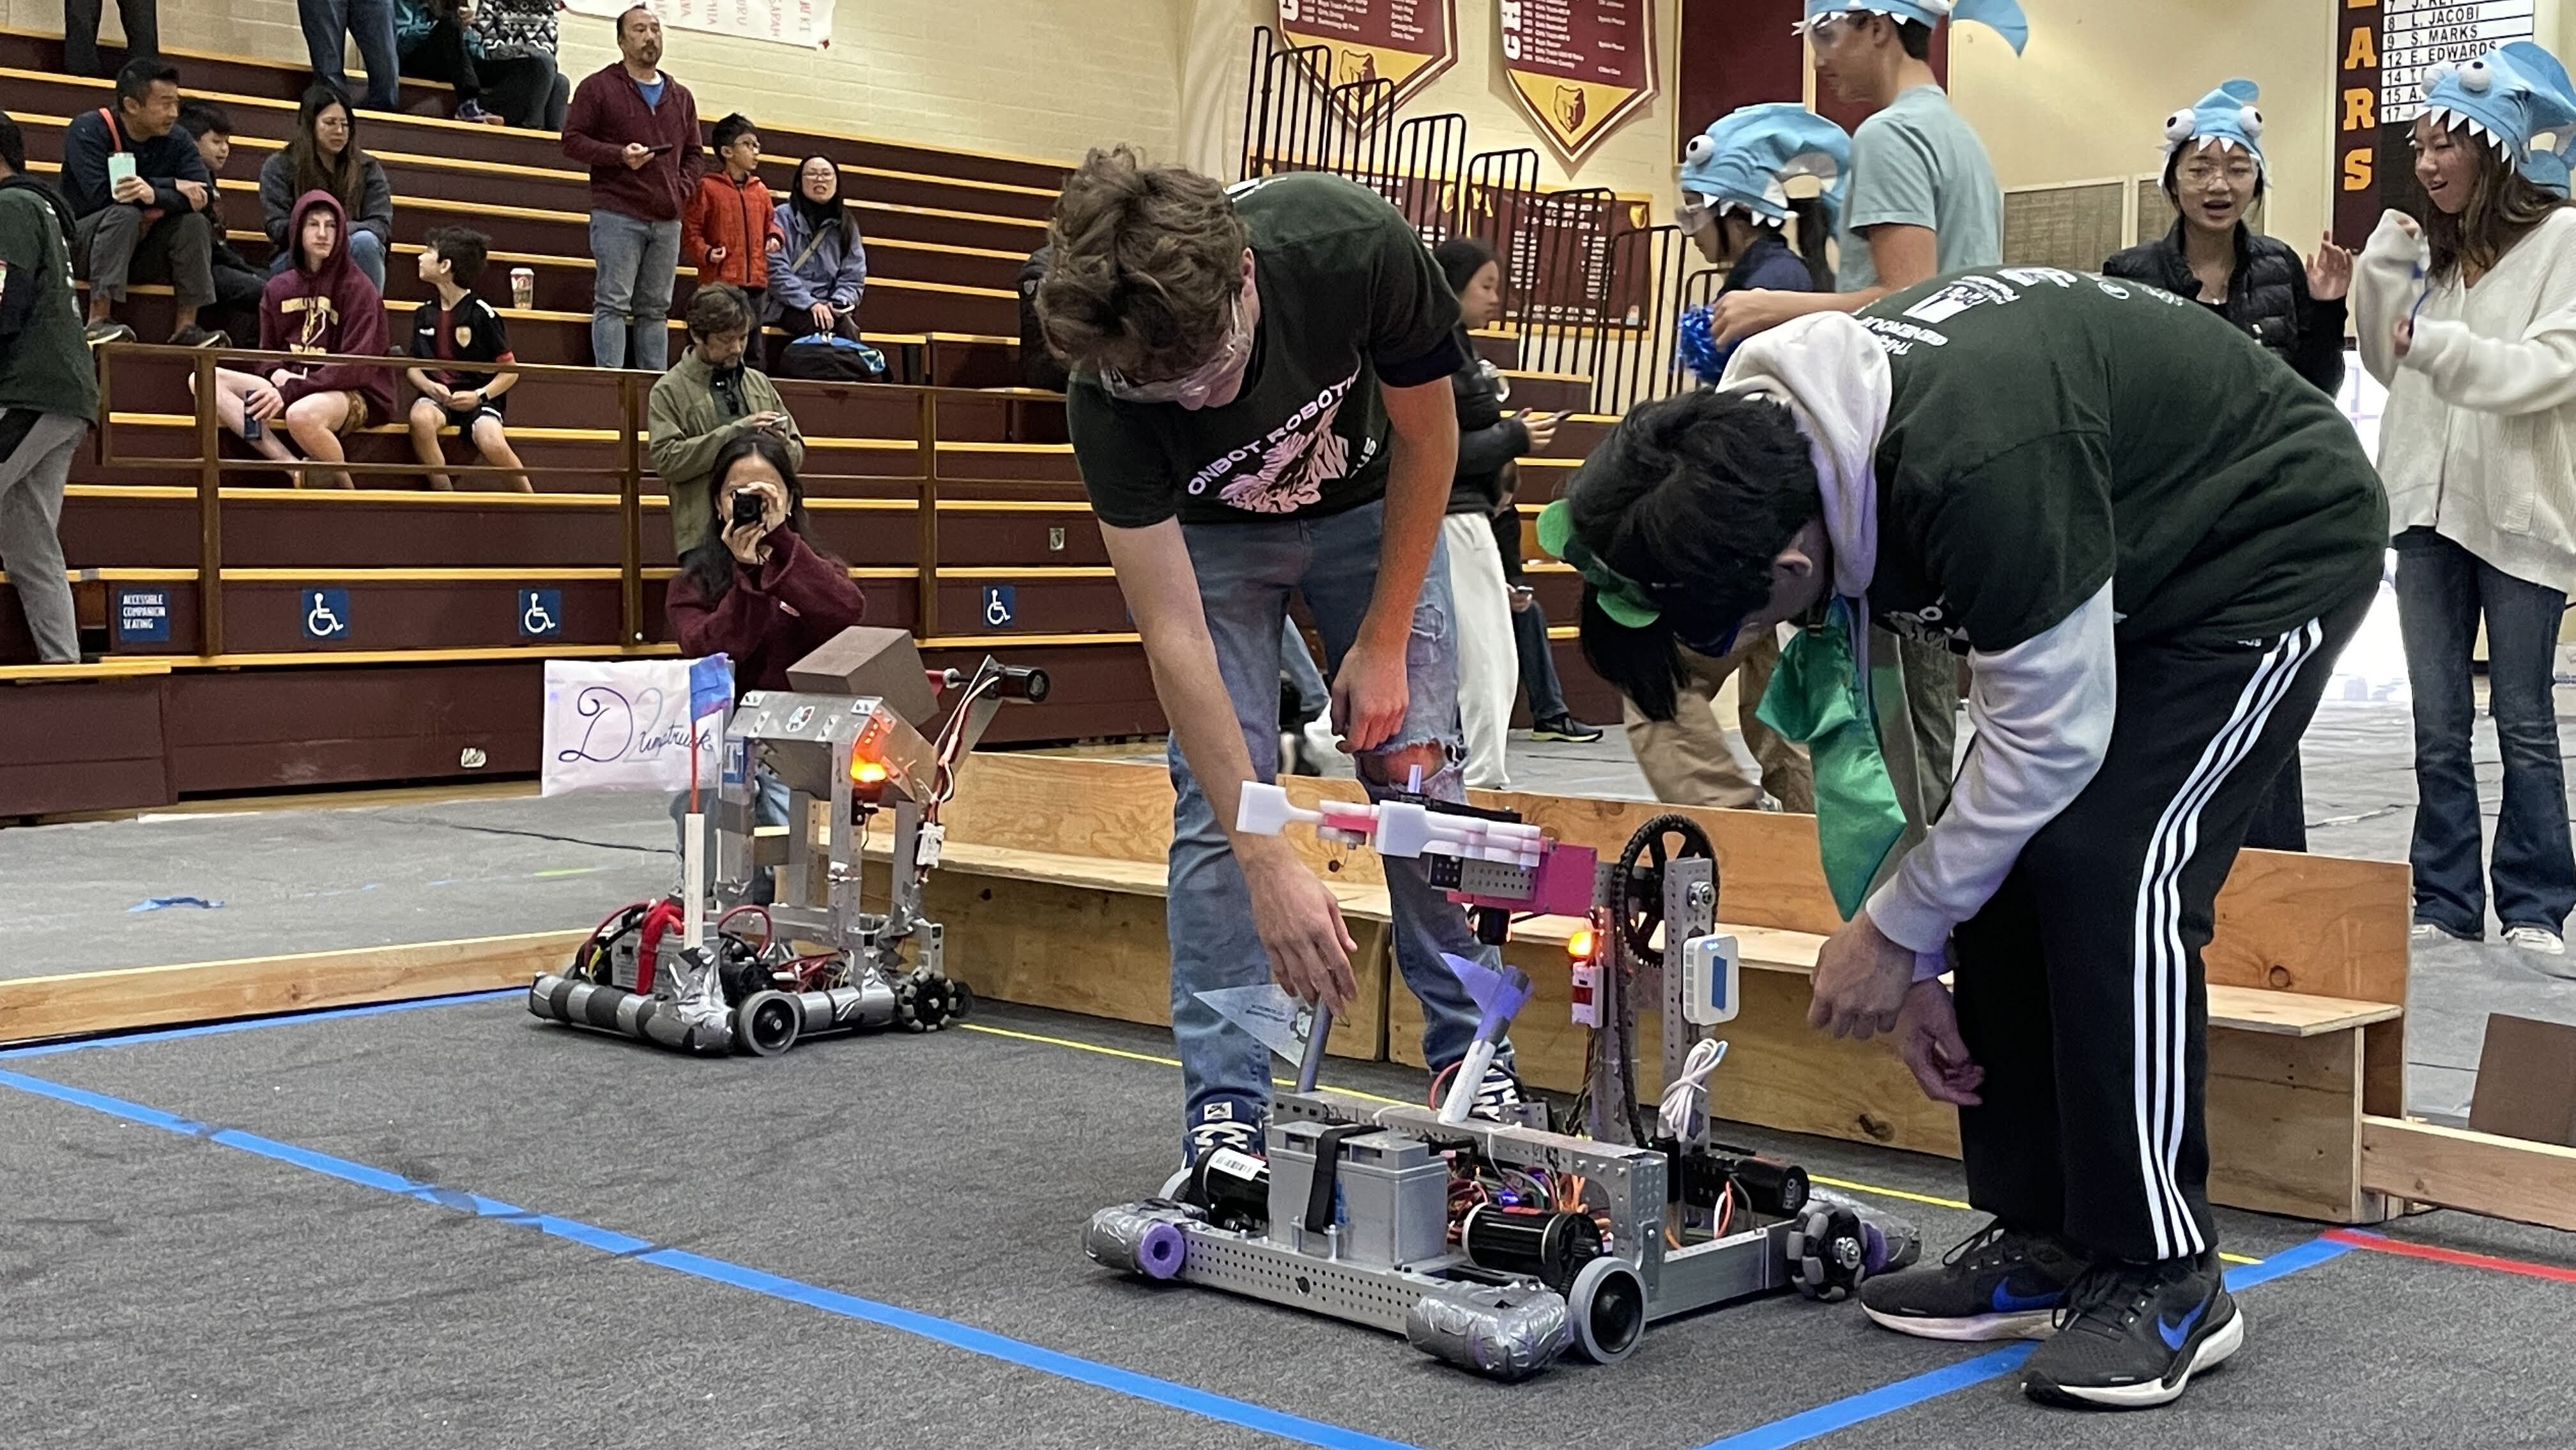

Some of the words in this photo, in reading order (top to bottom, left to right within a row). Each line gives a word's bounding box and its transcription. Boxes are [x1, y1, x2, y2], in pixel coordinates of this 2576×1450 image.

[2388, 17, 2395, 30] 8
[2412, 13, 2423, 26] L.
[2428, 7, 2479, 25] JACOBI
[2387, 35, 2395, 49] 9
[2411, 31, 2423, 46] S.
[2428, 25, 2478, 43] MARKS
[2388, 52, 2402, 68] 12
[2411, 50, 2423, 63] E.
[2388, 70, 2402, 86] 14
[2386, 88, 2400, 103] 15
[2386, 107, 2400, 121] 17
[123, 606, 165, 617] COMPANION
[123, 618, 153, 629] SEATING
